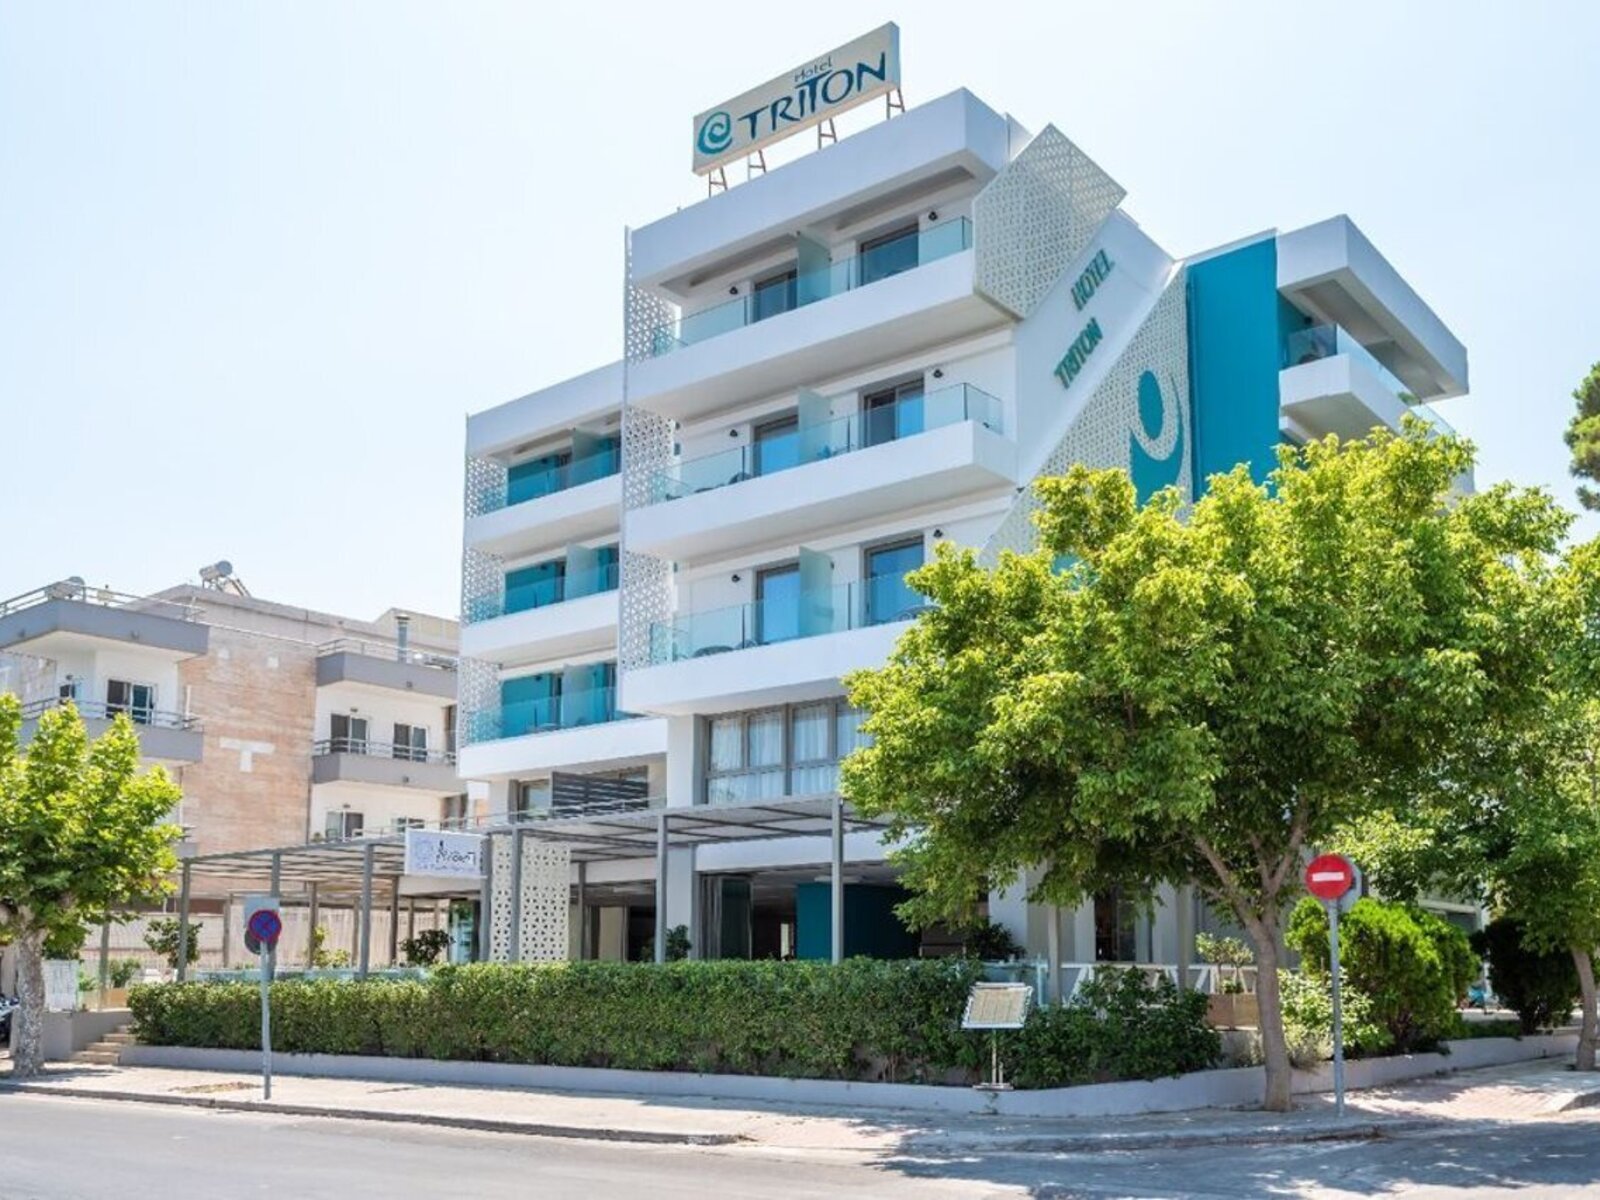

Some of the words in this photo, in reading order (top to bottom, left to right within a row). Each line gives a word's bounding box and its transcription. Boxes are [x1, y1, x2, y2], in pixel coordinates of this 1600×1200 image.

[737, 51, 886, 140] TRITON
[794, 56, 833, 83] Hotel
[1070, 249, 1115, 312] HOTEL
[1054, 317, 1103, 390] TRITON
